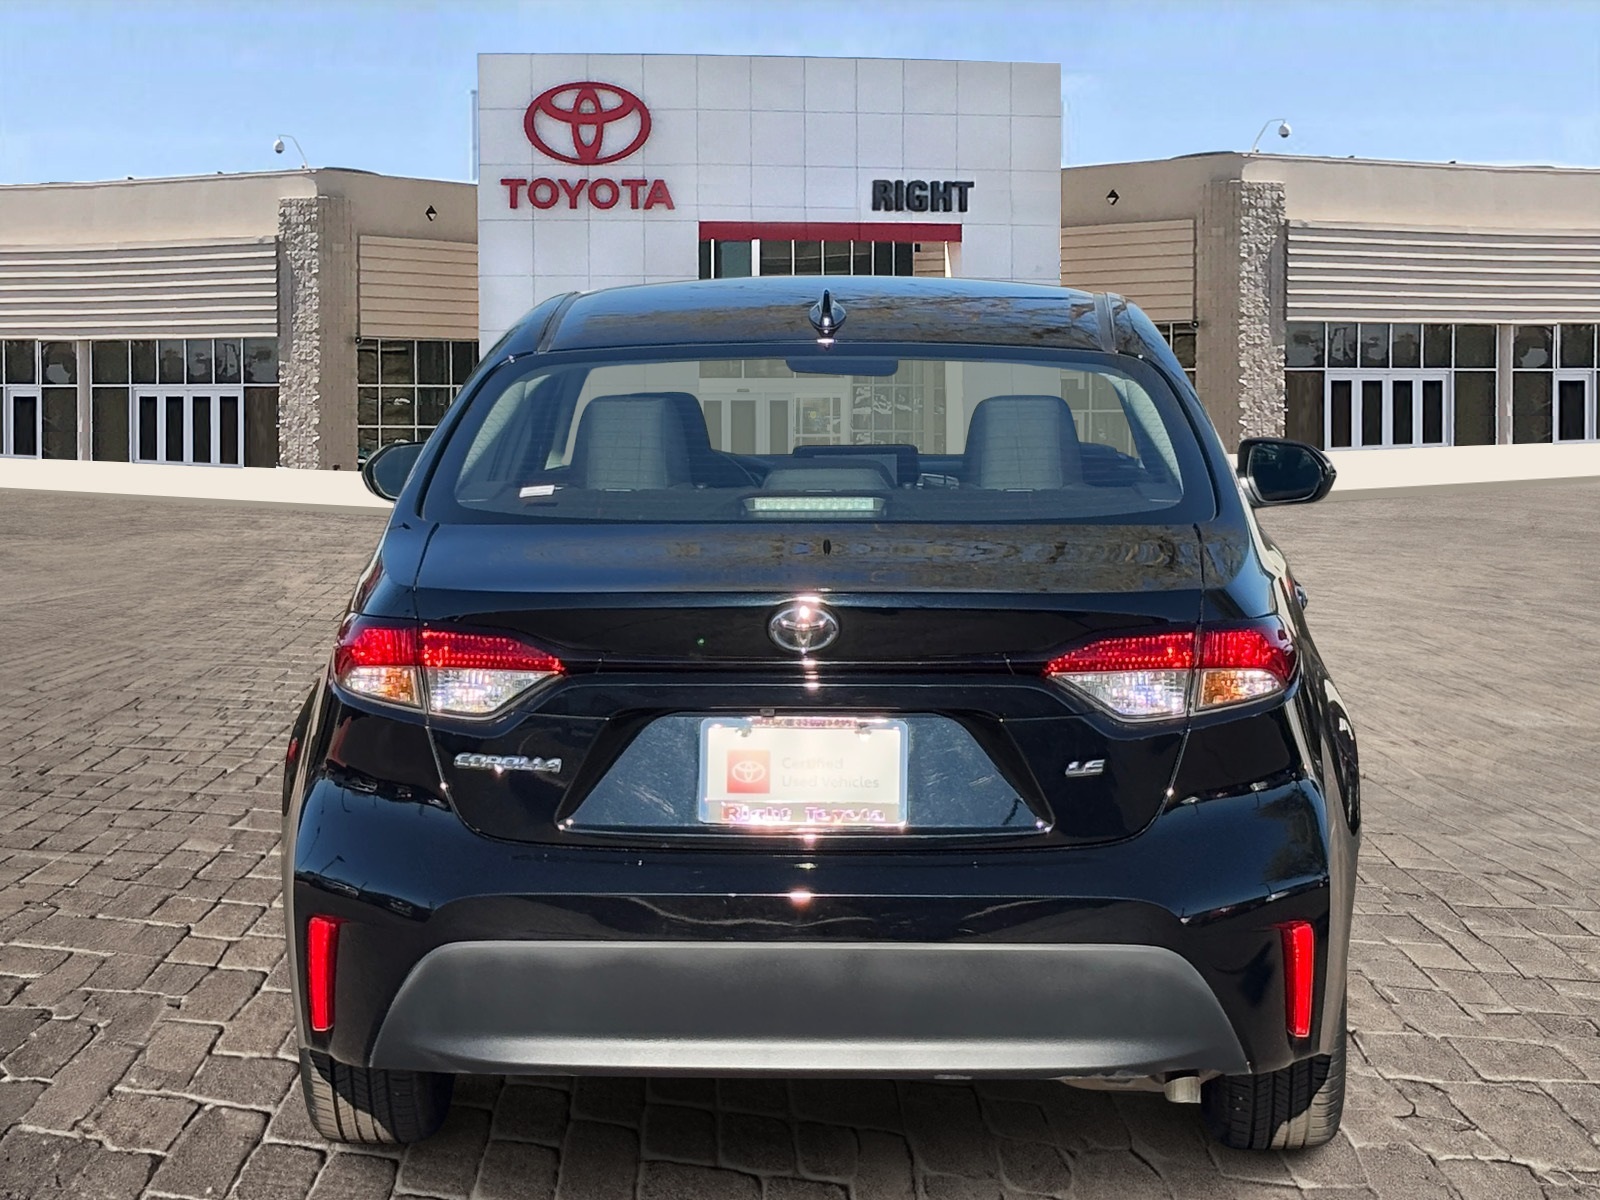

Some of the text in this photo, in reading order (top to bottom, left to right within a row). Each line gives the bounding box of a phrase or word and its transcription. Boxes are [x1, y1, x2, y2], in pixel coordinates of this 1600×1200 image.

[500, 178, 675, 210] TOYOTA
[871, 179, 975, 213] RIGHT
[782, 757, 843, 769] Certified
[1065, 759, 1105, 777] LE
[782, 775, 880, 788] Used Vehicles
[805, 806, 886, 823] Toyota
